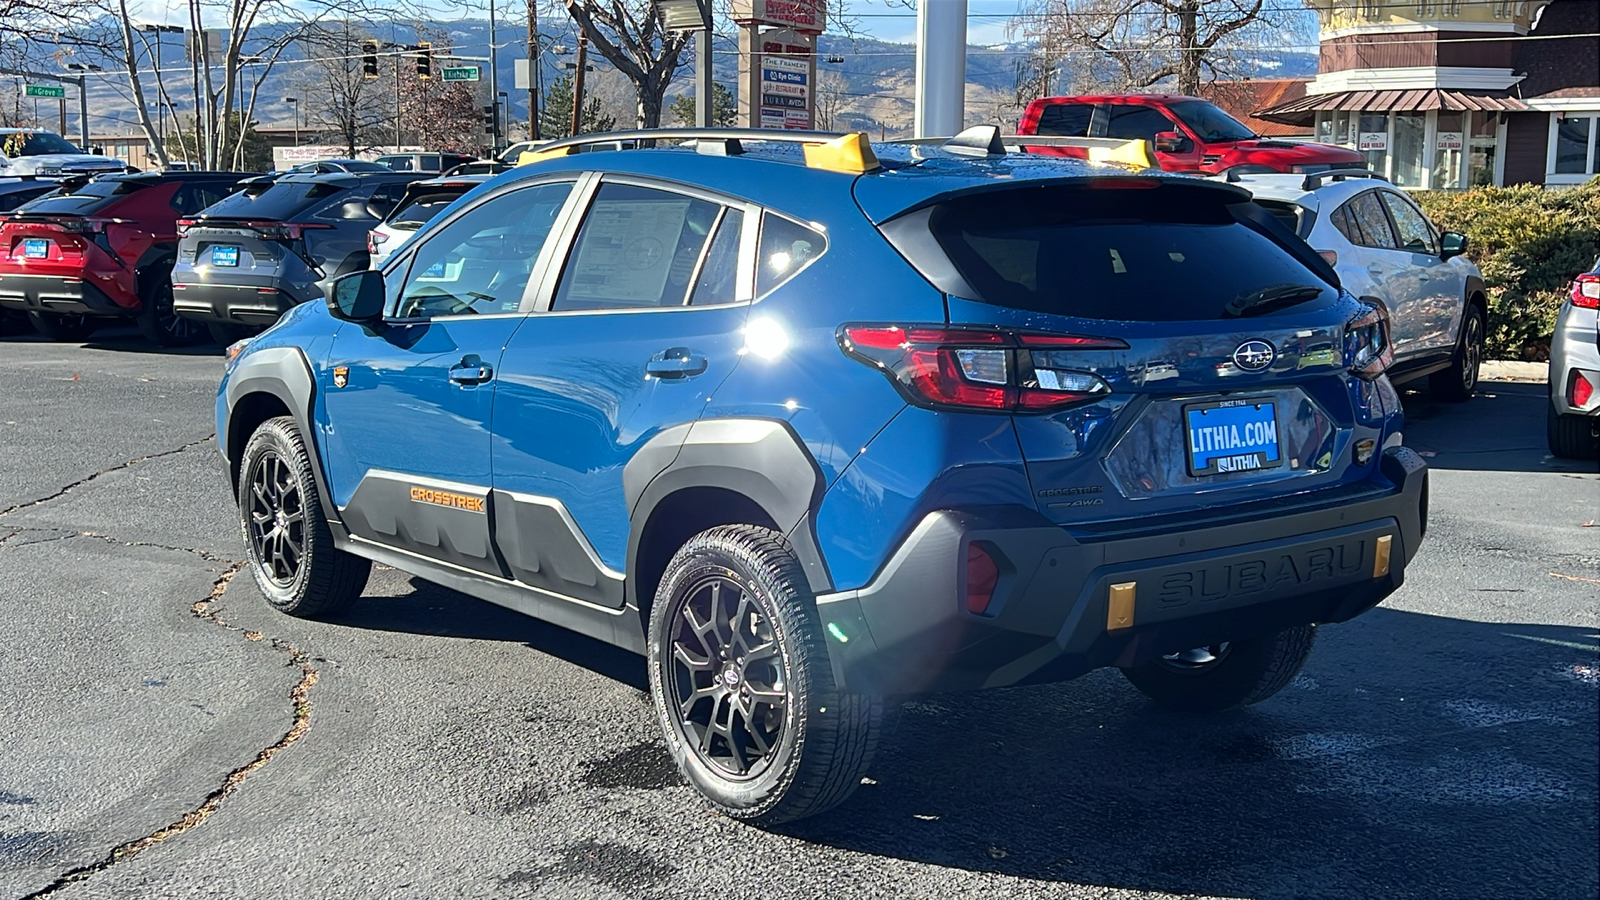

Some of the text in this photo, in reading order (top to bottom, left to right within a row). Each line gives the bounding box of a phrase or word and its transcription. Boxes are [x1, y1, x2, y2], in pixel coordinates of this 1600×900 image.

[778, 72, 801, 81] Eye Clinic
[37, 87, 56, 96] Grove
[776, 85, 799, 94] RESTAURANT
[1190, 420, 1277, 453] LITHIA.COM
[1227, 454, 1261, 471] LITHIA
[1038, 485, 1104, 498] CROSSTREK
[410, 487, 484, 512] CROSSTREK
[1069, 498, 1104, 508] AWD
[1158, 540, 1365, 610] SUBARU
